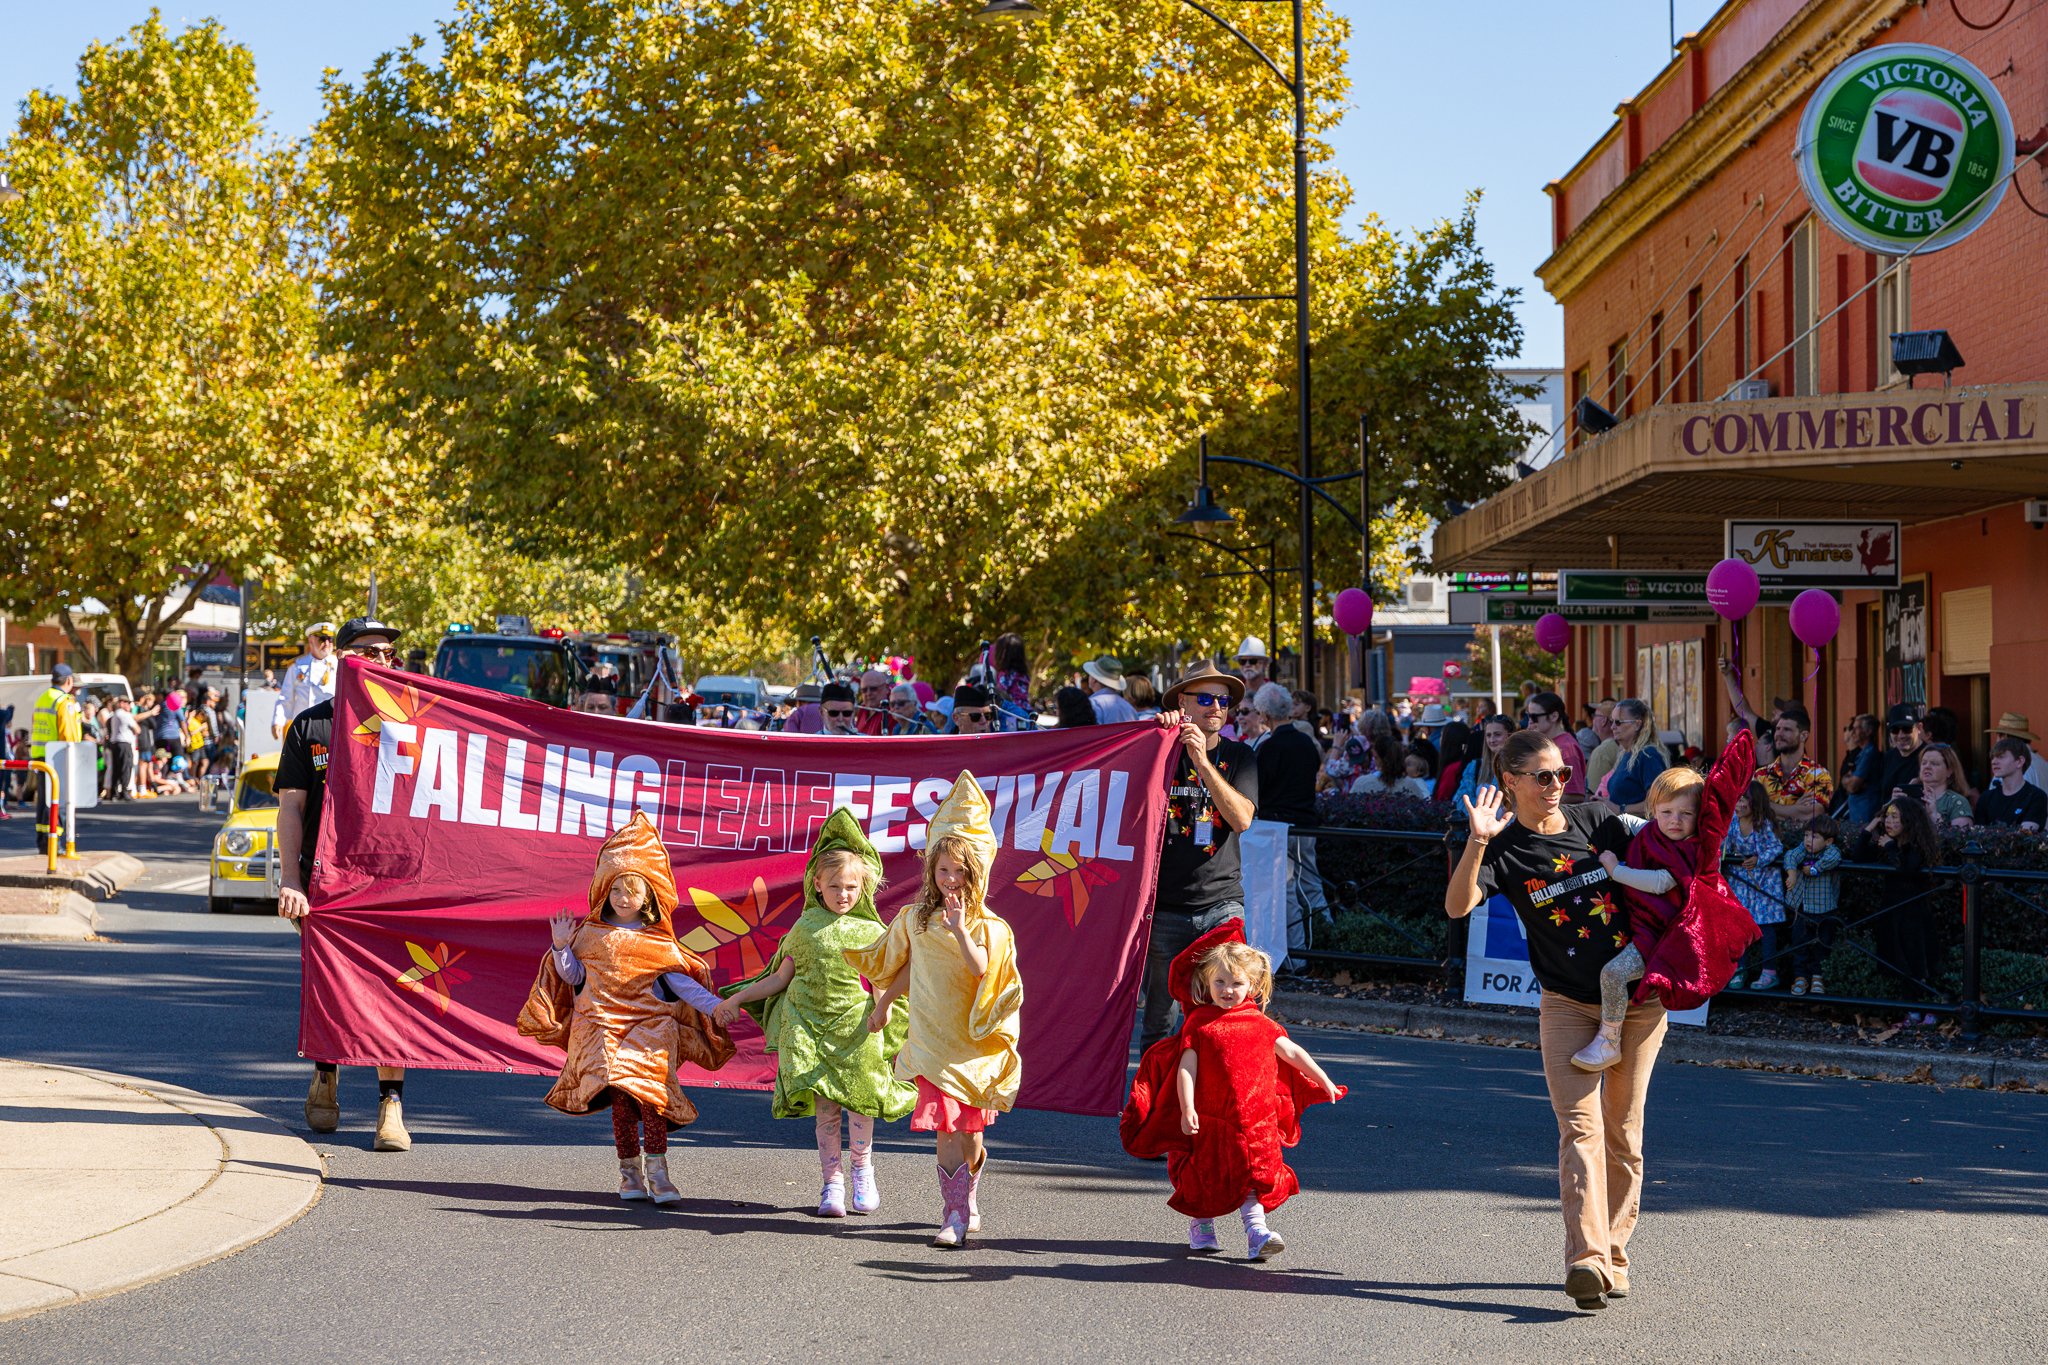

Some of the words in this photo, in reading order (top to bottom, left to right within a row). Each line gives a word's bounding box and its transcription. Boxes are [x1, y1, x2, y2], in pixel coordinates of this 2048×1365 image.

[1858, 63, 1989, 130] VICTORIA
[1827, 115, 1857, 134] SINCE
[1874, 110, 1955, 179] VB
[1967, 161, 1988, 180] 1854
[1833, 177, 1948, 233] BITTER
[1682, 398, 2036, 457] COMMERCIAL
[1736, 528, 1854, 570] Kinnaree
[1646, 581, 1706, 594] VICTOR
[1520, 604, 1584, 616] VICTORIA
[1586, 604, 1636, 616] BITTER
[191, 650, 235, 664] Vacancy
[1528, 882, 1566, 905] FALLING
[1482, 972, 1524, 993] FOR
